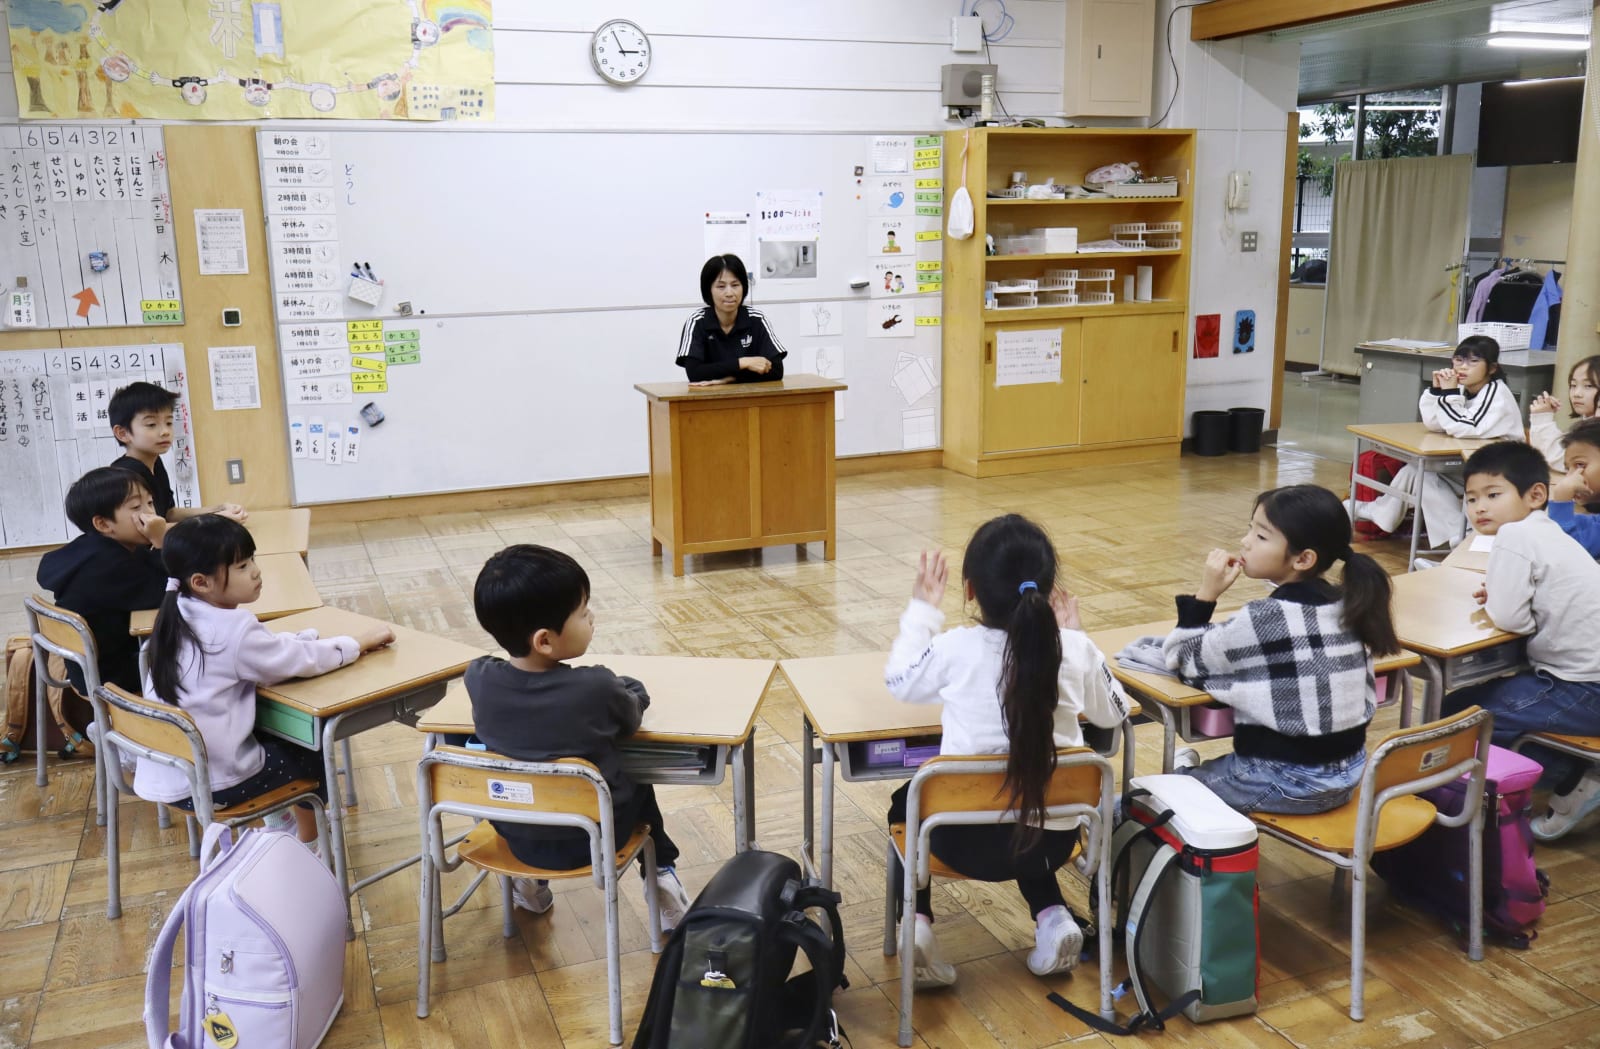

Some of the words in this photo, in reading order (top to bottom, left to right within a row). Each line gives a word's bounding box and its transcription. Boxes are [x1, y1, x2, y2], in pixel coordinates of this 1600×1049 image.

[27, 130, 38, 147] 6
[48, 131, 60, 145] 5
[68, 131, 79, 145] 4
[88, 131, 100, 145] 3
[107, 131, 118, 145] 2
[130, 131, 136, 144] 1
[50, 156, 67, 198] せいかつ
[74, 157, 87, 197] しゅわ
[93, 156, 106, 198] たいいく
[112, 156, 124, 198] さんすう
[130, 156, 144, 197] にほんご
[52, 355, 62, 369] 6
[71, 356, 82, 371] 5
[89, 355, 102, 369] 4
[110, 354, 121, 369] 3
[129, 353, 140, 368] 2
[150, 354, 156, 367] 1
[76, 392, 88, 422] 生活
[96, 388, 108, 419] 手話
